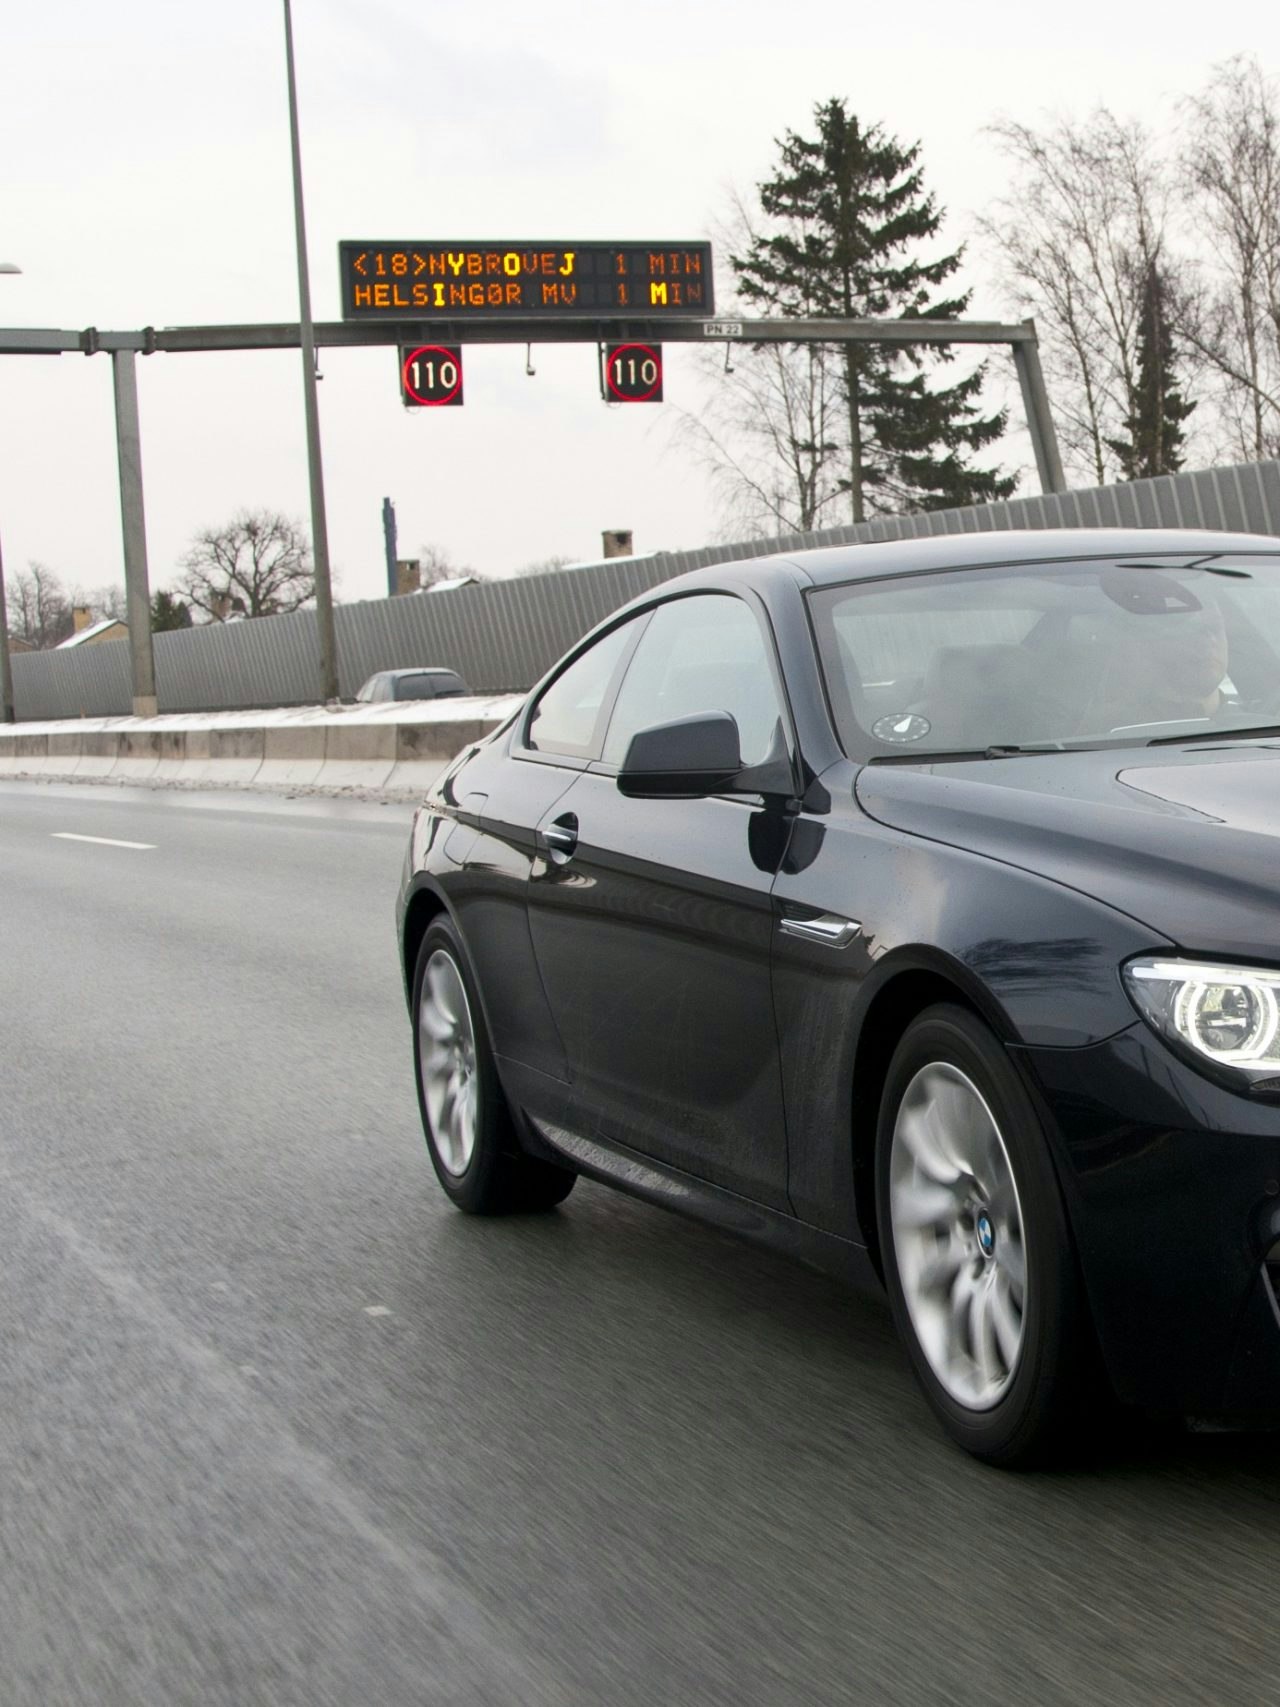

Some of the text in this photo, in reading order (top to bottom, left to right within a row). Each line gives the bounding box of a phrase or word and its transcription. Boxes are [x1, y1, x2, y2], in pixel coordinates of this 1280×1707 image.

[616, 253, 628, 275] 1
[649, 252, 701, 275] MIN
[354, 283, 522, 306] HELSINGØR
[618, 282, 629, 305] 1
[650, 282, 701, 305] MIN
[706, 324, 739, 334] PN 22
[411, 361, 457, 389] 110
[614, 359, 657, 385] 110
